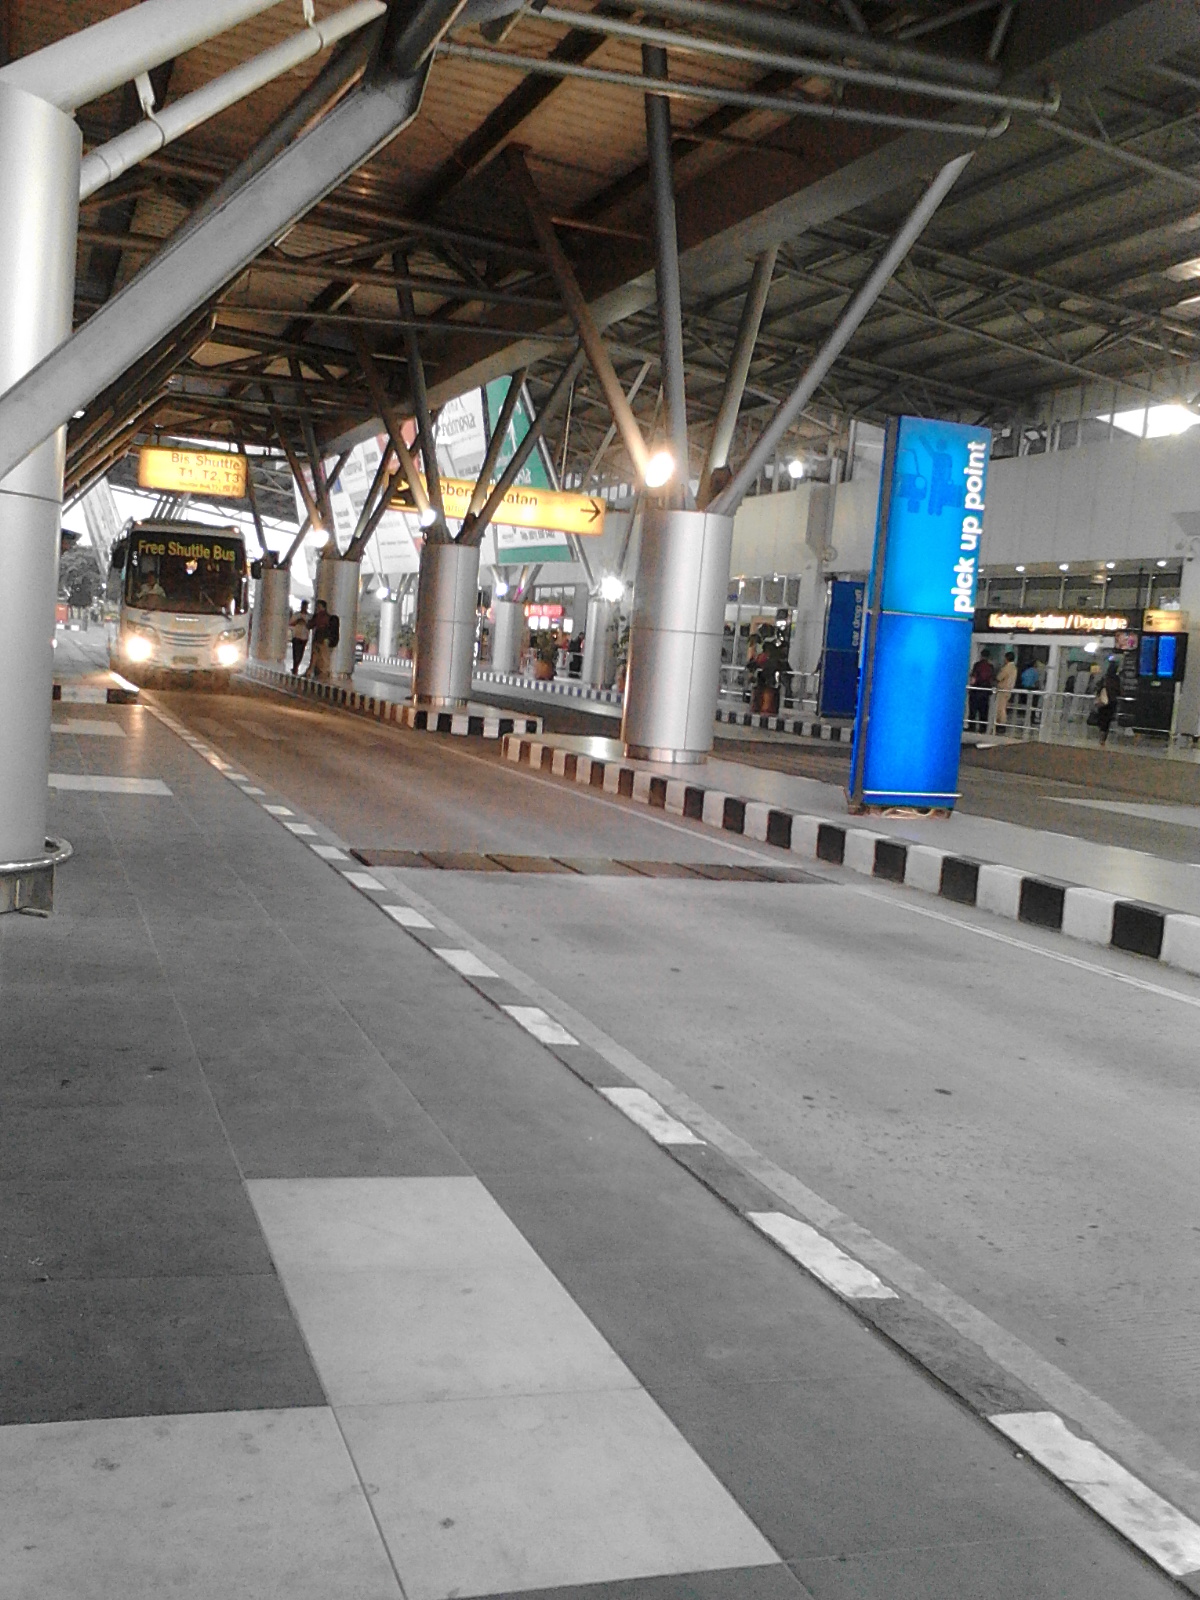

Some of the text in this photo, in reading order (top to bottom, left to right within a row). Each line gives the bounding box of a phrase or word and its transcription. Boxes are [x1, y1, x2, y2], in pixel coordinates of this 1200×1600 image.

[171, 452, 241, 471] Bis Shuttle
[224, 471, 240, 483] T3
[950, 440, 987, 614] pick up point
[138, 540, 236, 562] Free Shuttle Bus
[1074, 614, 1128, 632] Departure
